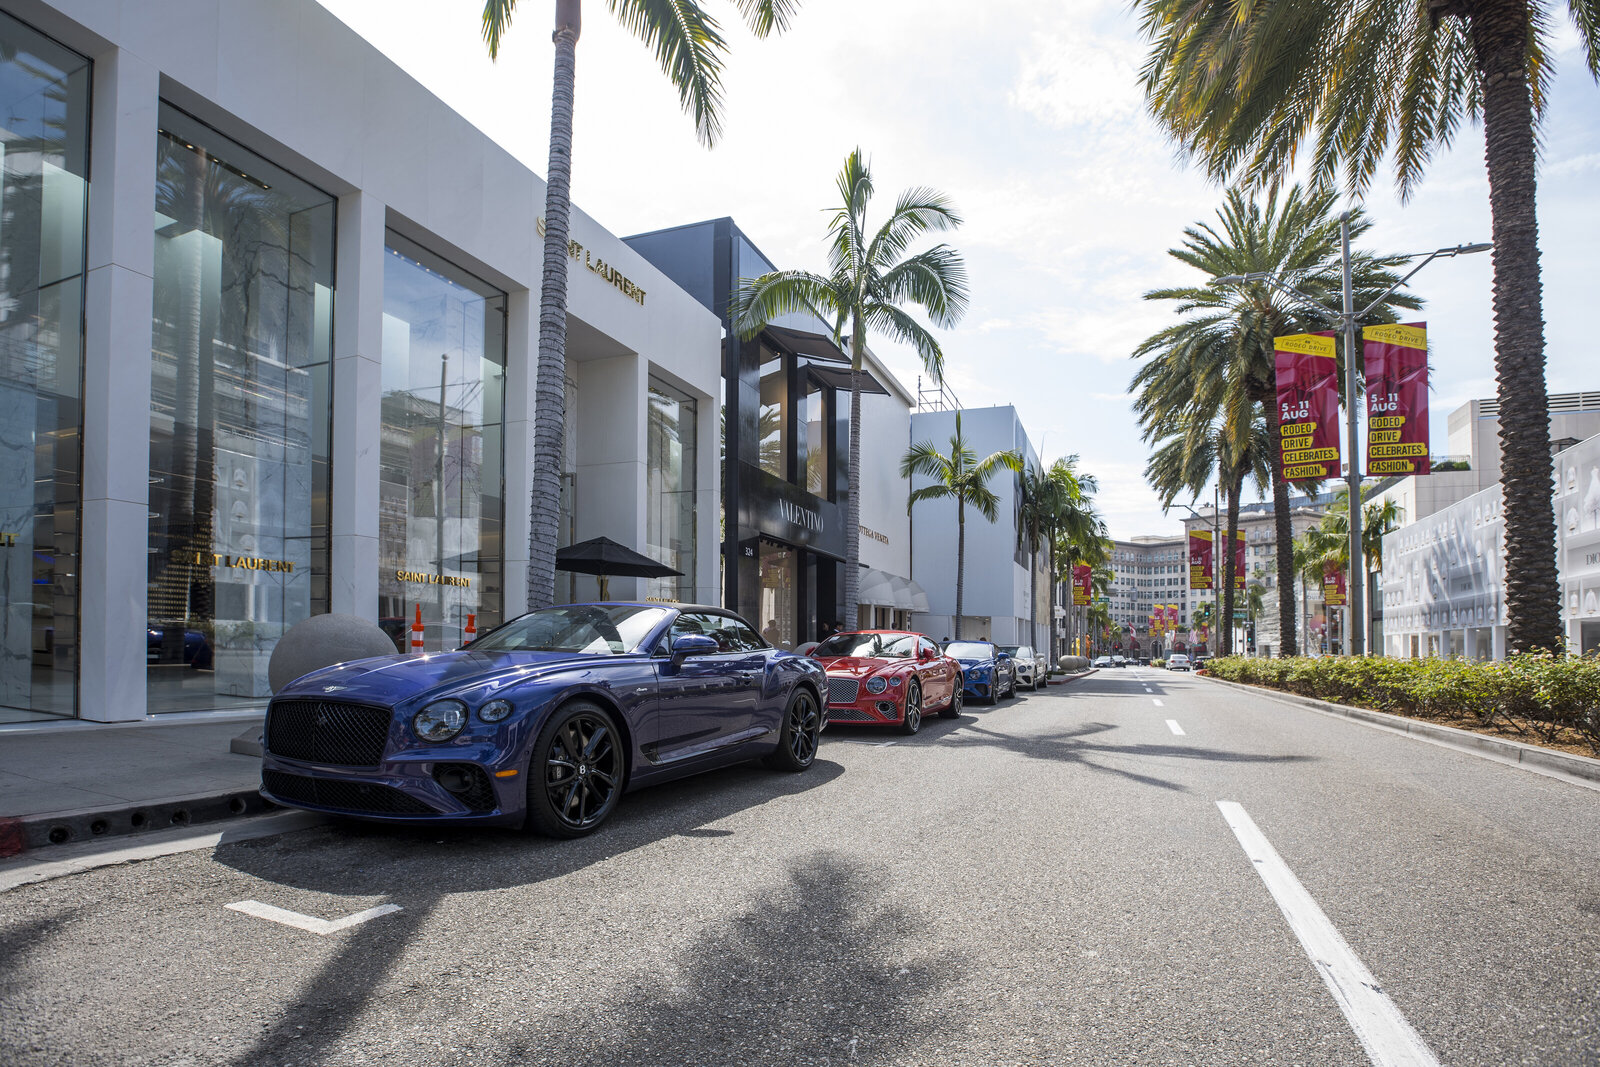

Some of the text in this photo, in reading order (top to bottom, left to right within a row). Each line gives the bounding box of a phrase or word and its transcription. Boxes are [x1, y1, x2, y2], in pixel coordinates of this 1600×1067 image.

[585, 250, 647, 306] LAURENT
[1375, 331, 1397, 339] RODEO
[1399, 335, 1418, 343] DRIVE
[1371, 394, 1378, 402] 5
[1387, 393, 1398, 402] 11
[1281, 402, 1289, 411] 5
[1298, 400, 1309, 409] 11
[1370, 402, 1398, 412] AUG
[1281, 409, 1309, 420] AUG
[1371, 417, 1400, 427] RODEO
[1283, 423, 1312, 435] RODEO
[1371, 431, 1397, 442] DRIVE
[1284, 437, 1310, 449] DRIVE
[1284, 449, 1334, 462] CELEBRATES
[1371, 445, 1422, 456] CELEBRATES
[1285, 465, 1321, 477] FASHION
[1371, 460, 1408, 471] FASHION
[779, 498, 824, 533] VALENTINO
[745, 546, 754, 557] 324
[225, 555, 297, 573] LAURENT
[396, 570, 472, 588] SAINT LAURENT
